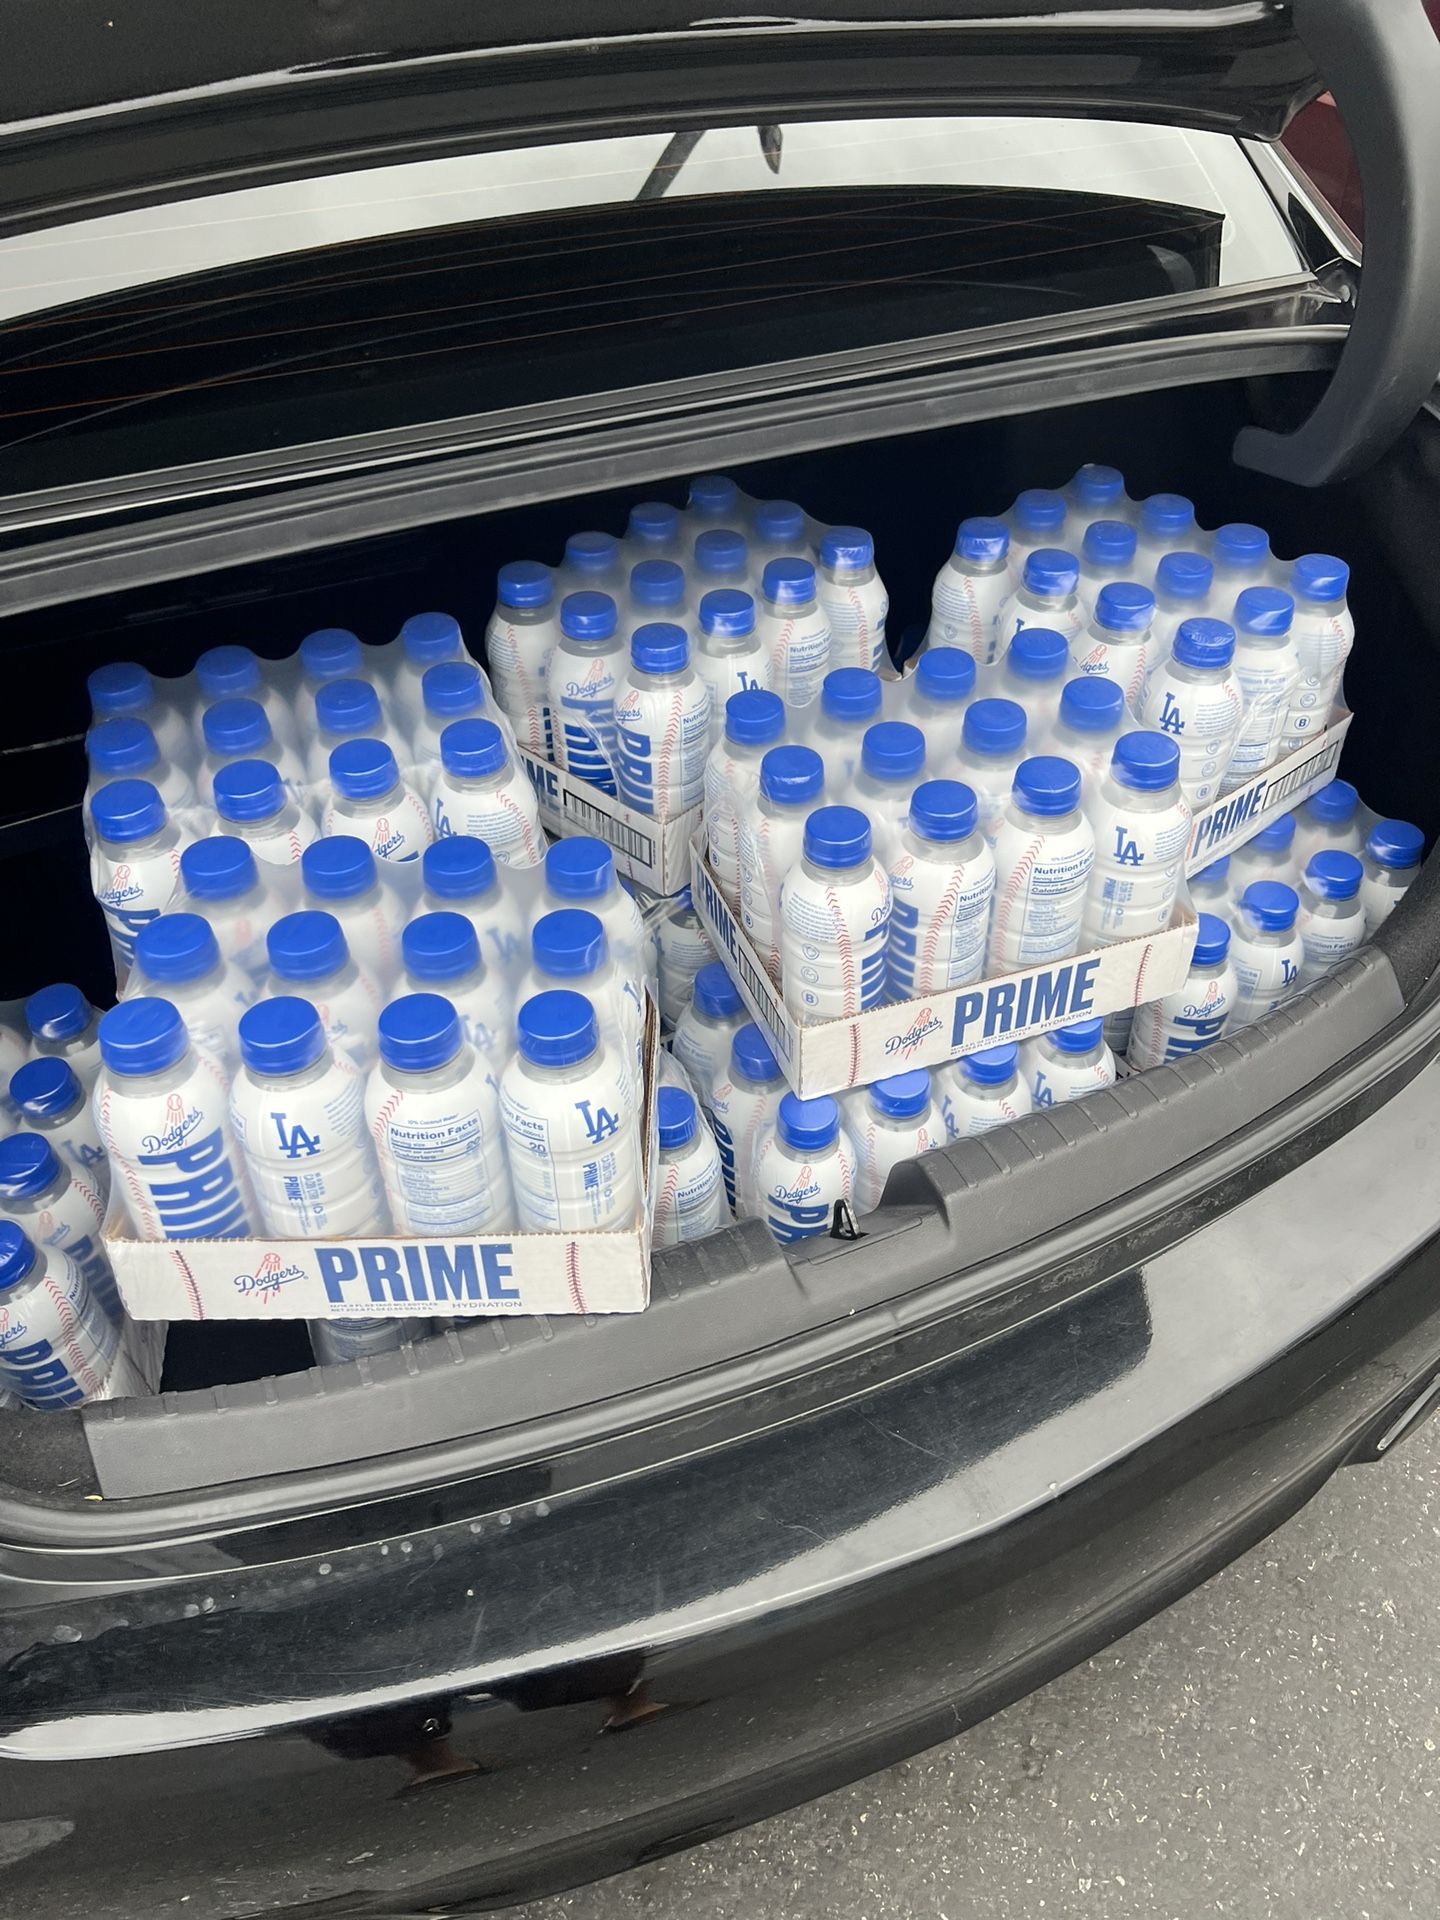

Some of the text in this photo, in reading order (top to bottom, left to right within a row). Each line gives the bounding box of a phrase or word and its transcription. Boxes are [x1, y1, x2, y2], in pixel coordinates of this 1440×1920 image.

[566, 674, 615, 698] Dodgers
[1159, 692, 1185, 735] LA
[1192, 779, 1267, 859] PRIME
[1112, 826, 1145, 866] LA
[1034, 861, 1078, 875] Nutrition
[951, 957, 1101, 1048] PRIME
[1183, 994, 1226, 1018] Dodgers
[1040, 1009, 1093, 1030] HYDRATION
[885, 1017, 943, 1056] Dodgers
[142, 1106, 204, 1154] Dodgers
[270, 1112, 321, 1159] LA
[390, 1117, 479, 1140] Nutrition Facts
[514, 1113, 545, 1131] Facts
[575, 1100, 619, 1144] LA
[582, 1161, 600, 1190] PRIME
[283, 1175, 303, 1209] PRIME
[774, 1181, 821, 1205] Dodgers
[234, 1264, 305, 1293] Dodgers
[314, 1243, 520, 1303] PRIME
[452, 1301, 523, 1309] HYDRATION
